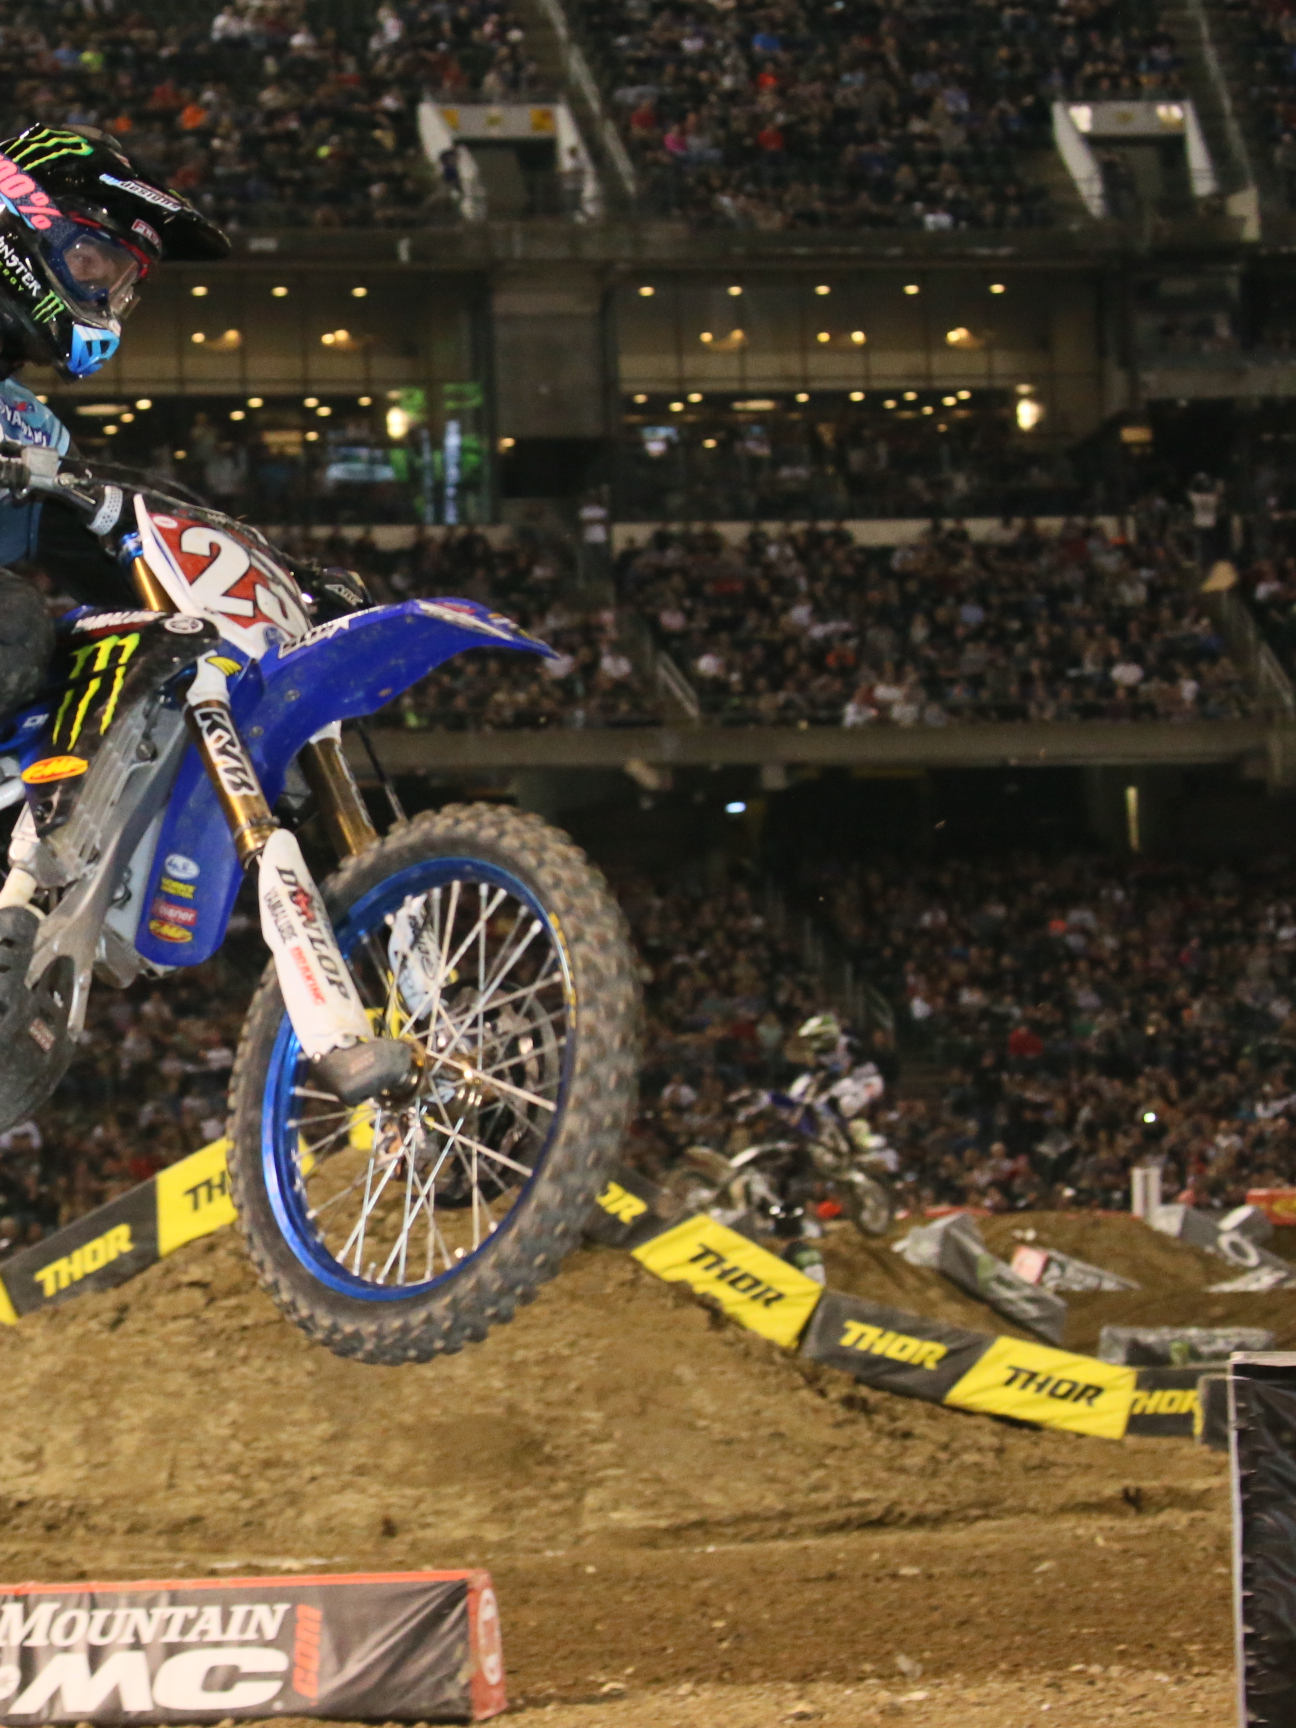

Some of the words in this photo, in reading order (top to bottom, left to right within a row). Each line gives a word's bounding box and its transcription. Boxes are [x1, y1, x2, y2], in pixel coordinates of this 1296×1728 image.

[184, 1170, 228, 1212] TH
[34, 1223, 135, 1298] THOR
[687, 1243, 787, 1308] THOR
[839, 1319, 948, 1370] THOR
[1004, 1365, 1105, 1407] THOR
